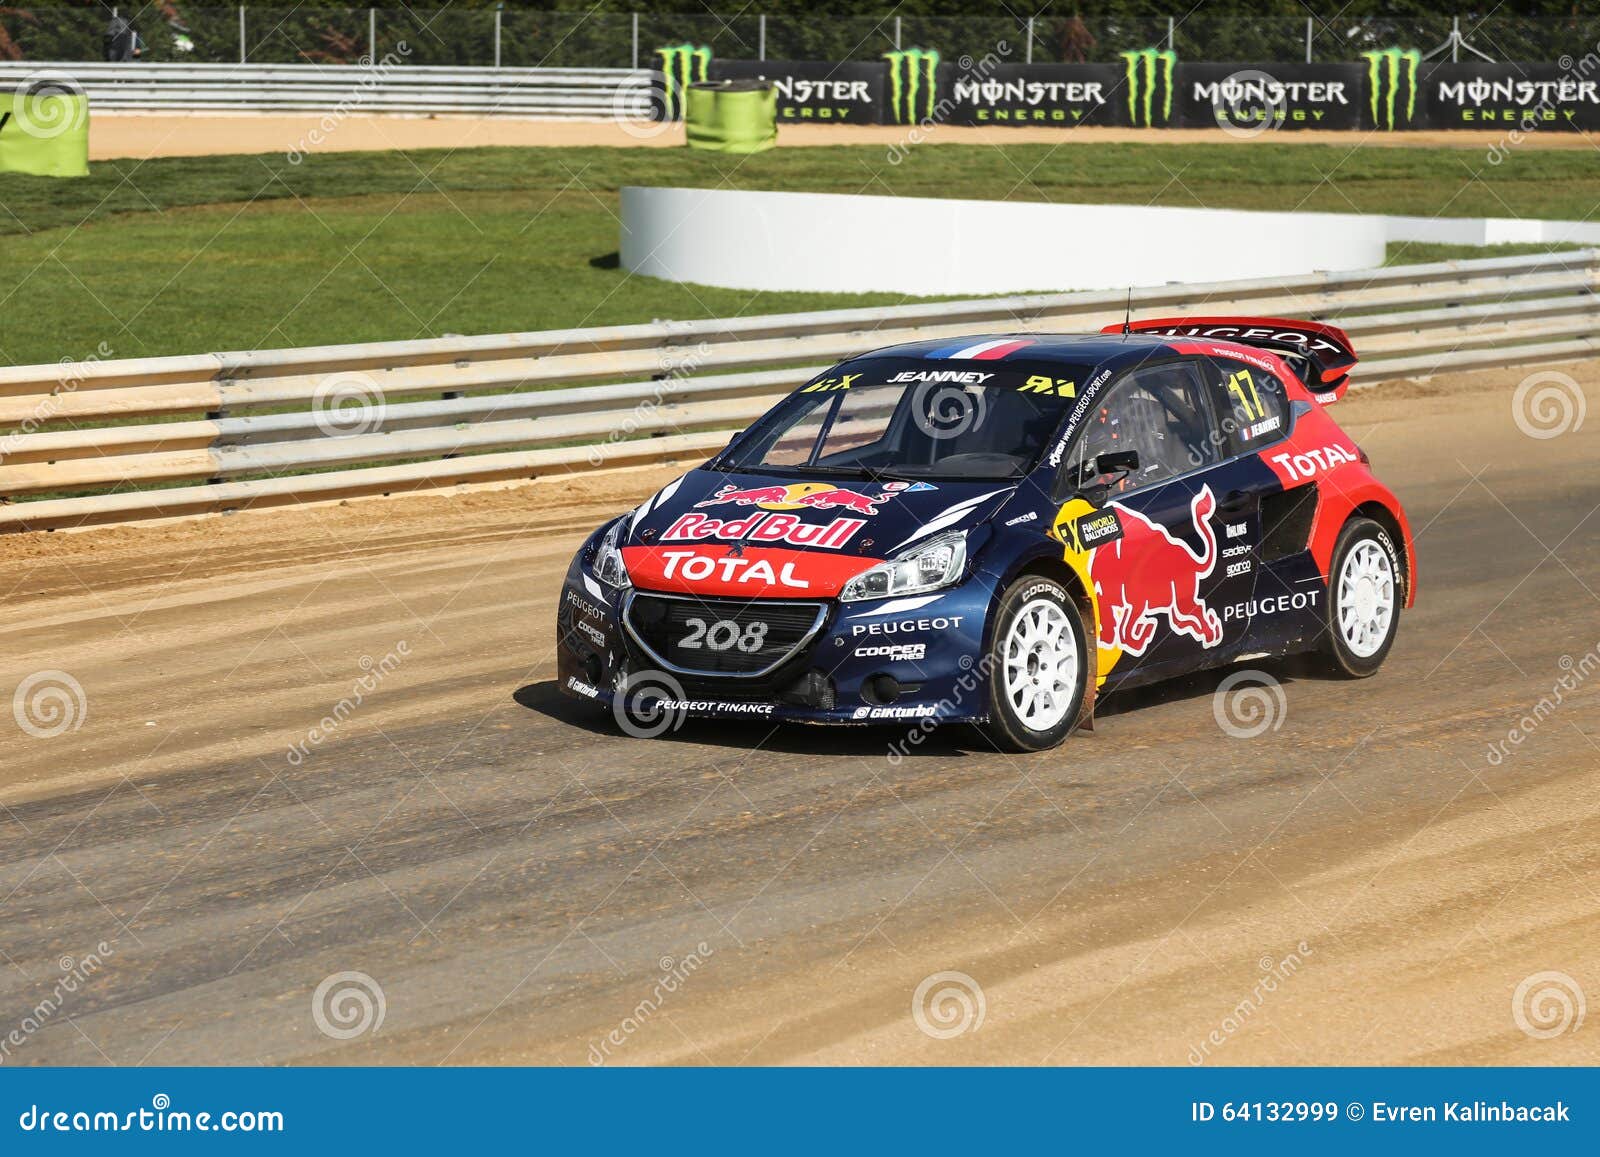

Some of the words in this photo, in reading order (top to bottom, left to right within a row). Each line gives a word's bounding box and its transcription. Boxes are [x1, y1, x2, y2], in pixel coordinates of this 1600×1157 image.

[774, 76, 872, 103] NSTER
[953, 78, 1106, 106] MONSTER
[1193, 78, 1348, 106] MONSTER
[783, 107, 849, 118] ERGY
[977, 109, 1084, 121] ENERGY
[1217, 109, 1325, 121] ENERGY
[1462, 109, 1576, 121] ENERGY
[887, 371, 995, 384] JEANNEY
[1228, 369, 1265, 421] 17
[1271, 443, 1358, 481] TOTAL
[660, 512, 757, 541] Red
[750, 513, 868, 549] Bull
[661, 551, 809, 589] TOTAL
[1022, 584, 1066, 602] COOPER
[567, 591, 606, 622] PEUGEOT
[1224, 590, 1320, 622] PEUGEOT
[678, 617, 769, 653] 208
[853, 616, 963, 636] PEUGEOT
[854, 643, 926, 657] COOPER
[889, 651, 925, 661] TIRES
[655, 700, 716, 712] PEUGEOT
[717, 702, 775, 714] FINANCE
